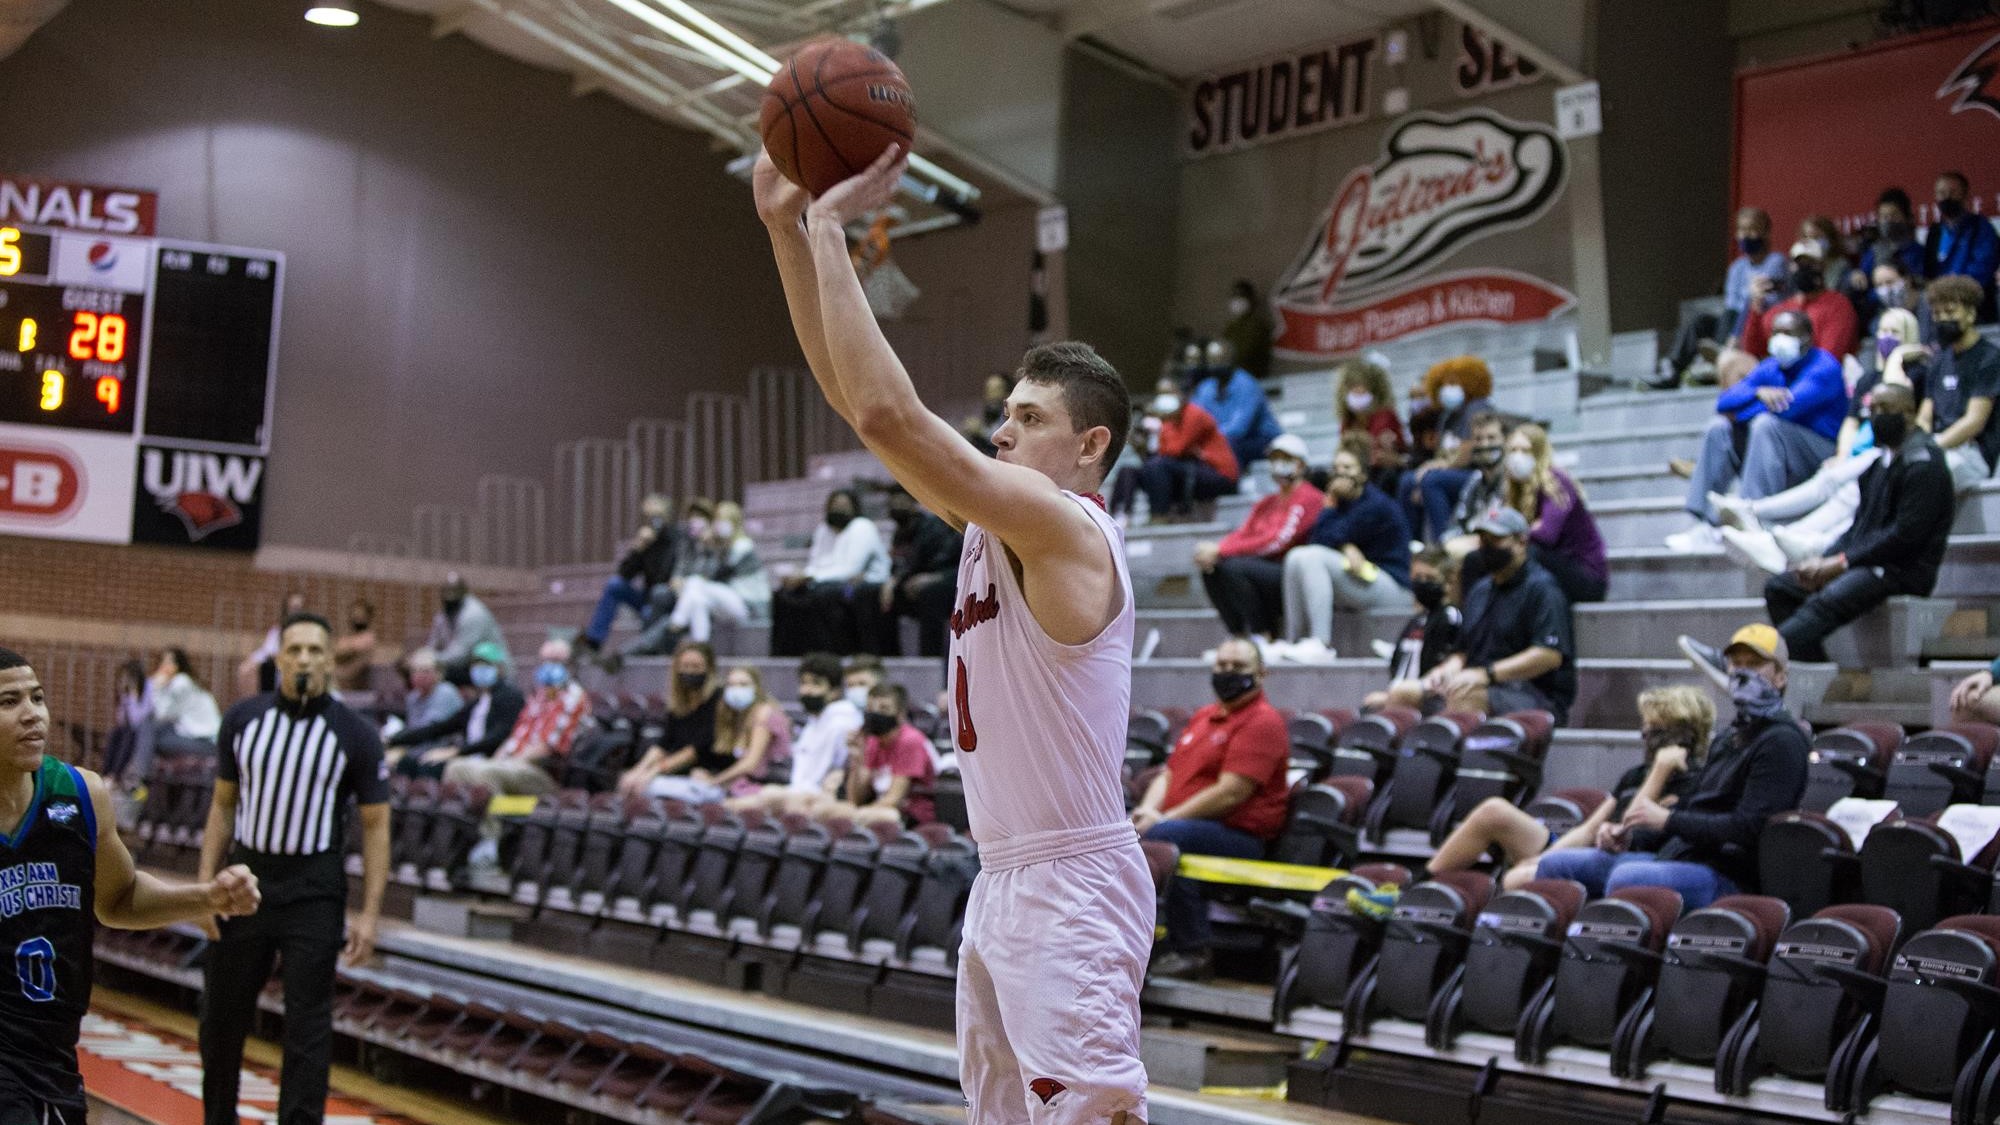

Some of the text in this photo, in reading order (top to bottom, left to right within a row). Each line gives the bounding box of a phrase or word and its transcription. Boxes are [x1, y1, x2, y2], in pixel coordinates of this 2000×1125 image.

[1189, 37, 1377, 151] STUDENT
[0, 181, 140, 234] NALS
[69, 310, 127, 362] 28
[40, 369, 65, 411] 3
[96, 375, 121, 413] 9
[143, 449, 262, 504] UIW
[27, 862, 60, 884] A&M
[0, 888, 24, 918] US
[15, 936, 57, 1002] 0
